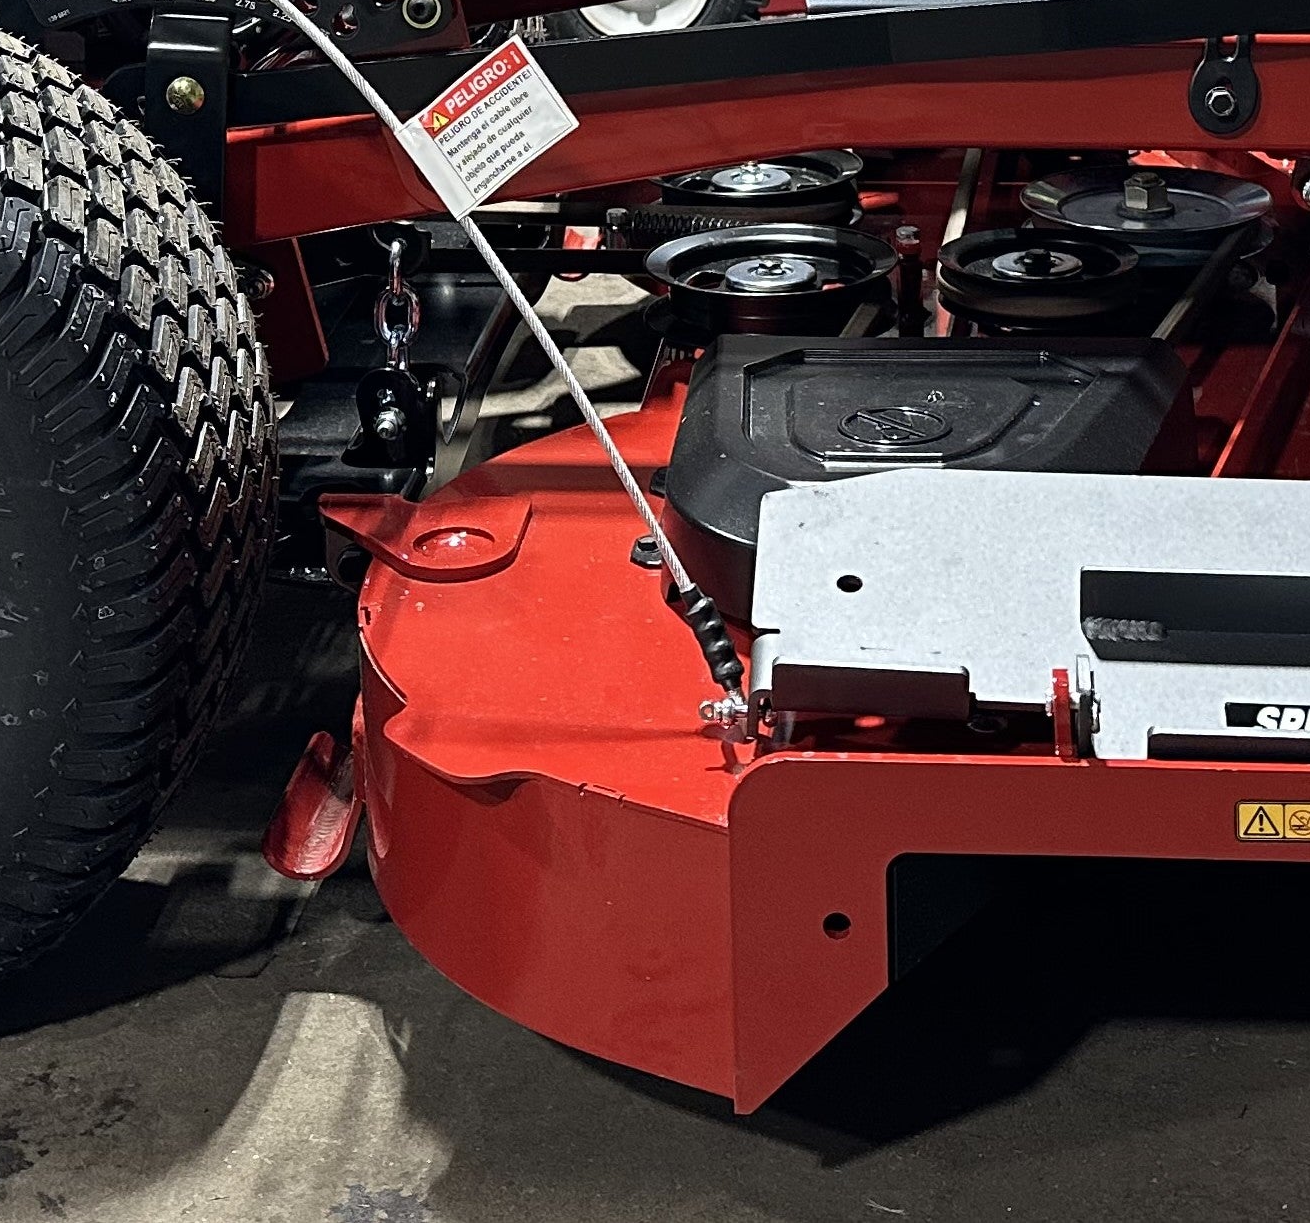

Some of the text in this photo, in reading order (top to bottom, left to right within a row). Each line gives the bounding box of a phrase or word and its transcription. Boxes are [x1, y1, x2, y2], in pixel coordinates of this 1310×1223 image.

[444, 58, 513, 115] PELIGRO:
[438, 118, 472, 146] PELIGRO
[471, 107, 484, 120] DE
[447, 127, 482, 159] Mantenga
[490, 104, 511, 124] cable
[510, 90, 530, 107] libre
[462, 142, 487, 167] alejado
[486, 133, 498, 145] de
[497, 105, 534, 136] cualquier
[465, 131, 526, 182] objeto que pueda
[473, 154, 517, 194] engancharse
